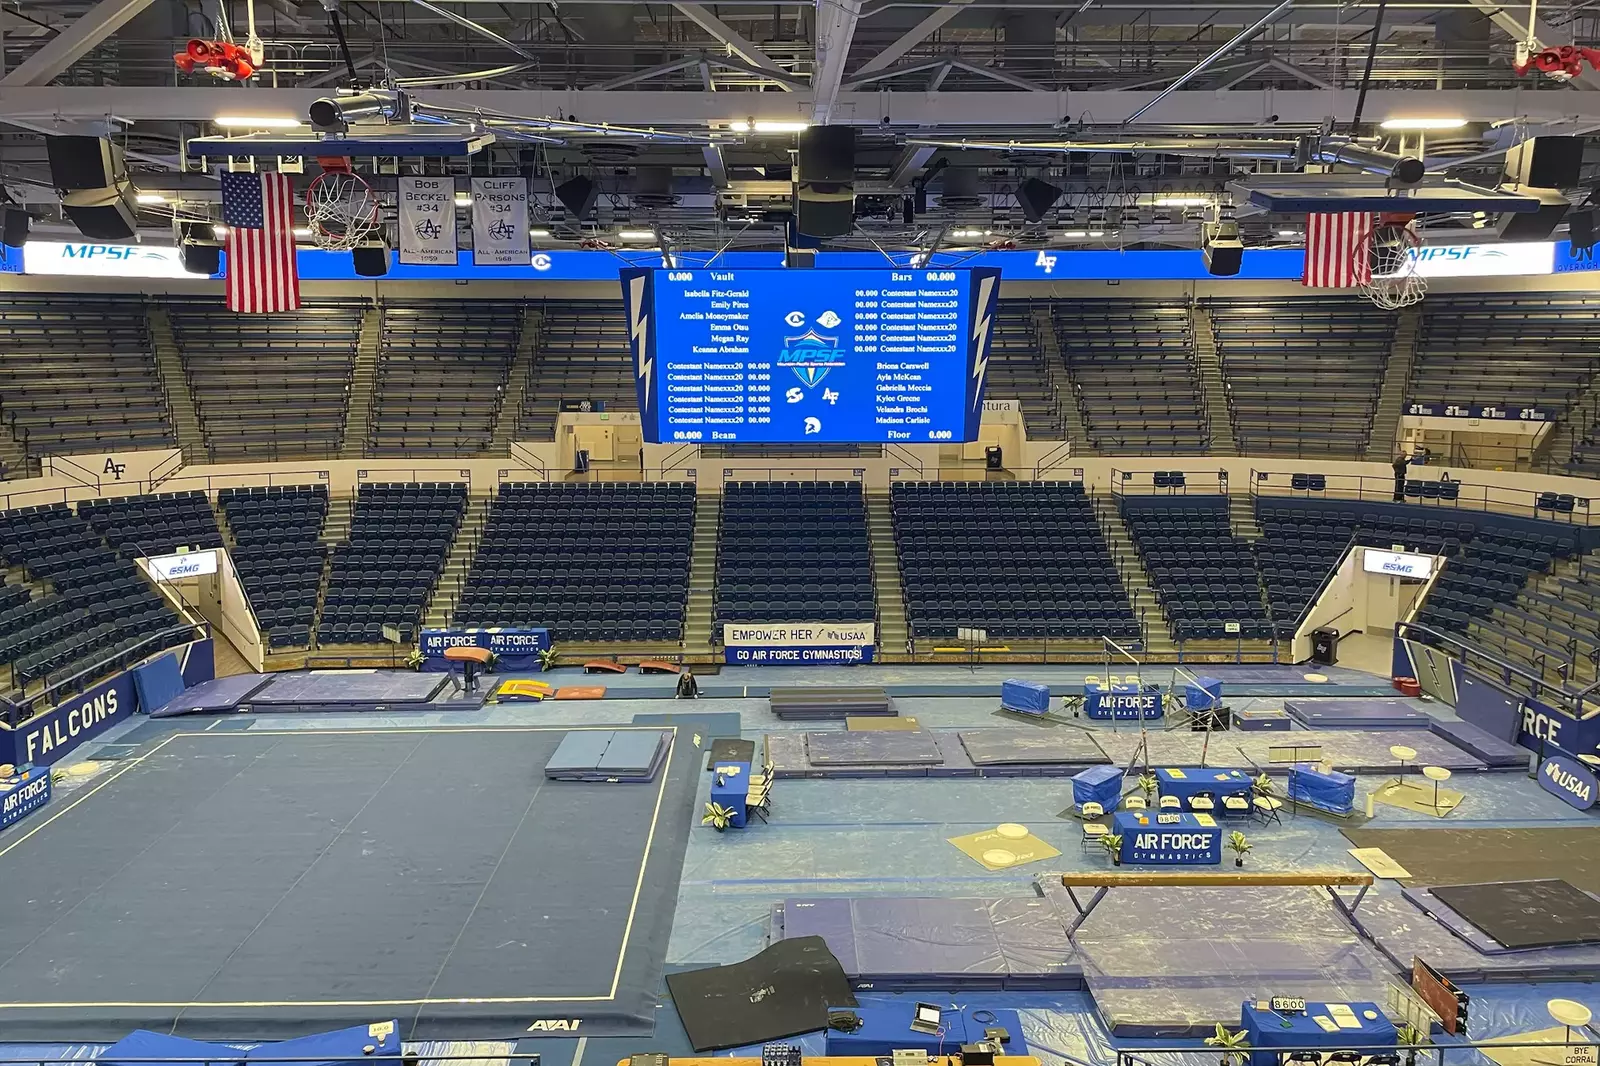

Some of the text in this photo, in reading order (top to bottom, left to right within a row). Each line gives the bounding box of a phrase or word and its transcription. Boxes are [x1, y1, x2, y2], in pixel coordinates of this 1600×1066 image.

[414, 180, 439, 189] BOB
[483, 180, 516, 190] CLIFF
[405, 192, 450, 201] BECKEL
[474, 193, 526, 202] PARSONS
[416, 203, 439, 212] #34
[489, 204, 512, 213] #34
[61, 244, 140, 260] MPSF
[1407, 246, 1480, 261] MPSF
[668, 272, 734, 282] 0.000 Vault
[891, 272, 956, 282] Bars 00.000
[882, 289, 916, 297] Contestant
[711, 301, 731, 310] Emily
[881, 300, 916, 308] Contestant
[679, 312, 704, 320] Amelia
[881, 312, 915, 320] Contestant
[710, 323, 732, 331] Emma
[880, 323, 915, 331] Contestant
[880, 334, 915, 342] Contestant
[880, 345, 915, 353] Contestant
[777, 349, 846, 362] MPSF
[667, 362, 702, 370] Contestant
[667, 373, 702, 381] Contestant
[667, 384, 703, 392] Contestant
[667, 395, 703, 403] Contestant
[668, 406, 703, 414] Contestant
[668, 416, 703, 424] Contestant
[875, 416, 904, 424] Madison
[673, 430, 737, 440] 00.000 Beam
[887, 430, 952, 439] Floor 0.000
[732, 629, 813, 640] EMPOWER HER
[840, 631, 866, 641] USAA
[427, 635, 477, 647] AIR FORCE
[491, 635, 539, 645] AIR FORCE
[737, 650, 750, 660] GO
[752, 650, 767, 660] AIR
[769, 650, 800, 660] FORCE
[1098, 696, 1156, 708] AIR FORCE
[26, 688, 118, 762] FALCONS
[1558, 770, 1591, 803] USAA
[2, 775, 48, 814] AIR FORCE
[1134, 833, 1213, 850] AIR FORCE
[1133, 851, 1212, 860] GYMNASTICS
[1274, 1000, 1305, 1009] 8600
[1574, 1046, 1590, 1055] BYE
[1565, 1055, 1597, 1064] CORRAL
